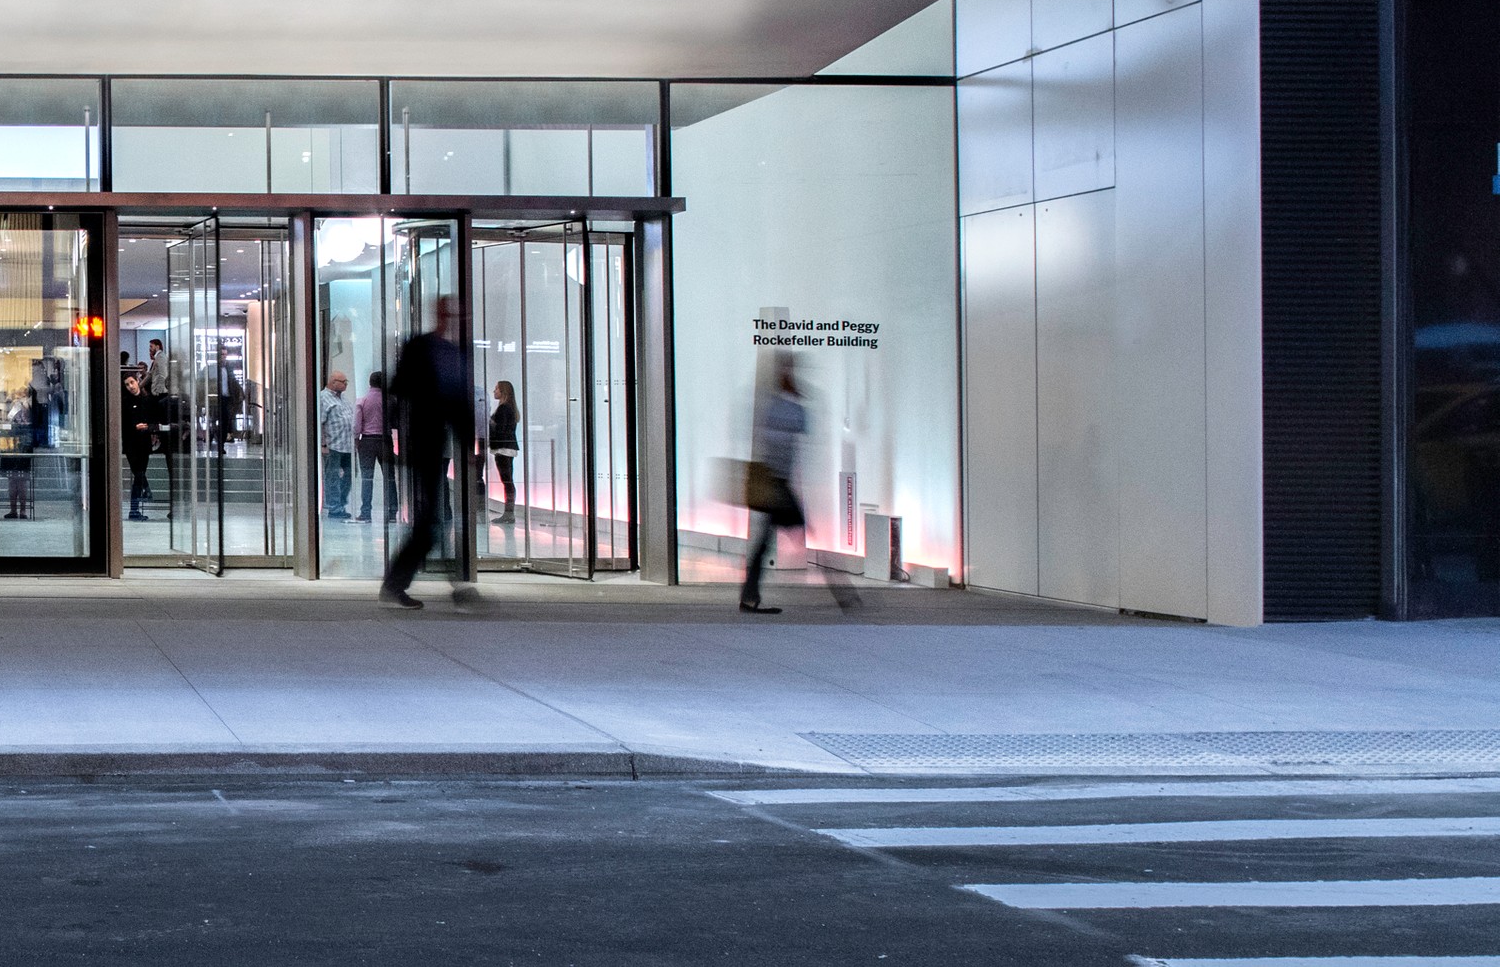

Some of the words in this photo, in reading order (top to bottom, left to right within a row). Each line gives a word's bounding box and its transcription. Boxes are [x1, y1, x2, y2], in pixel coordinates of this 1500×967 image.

[752, 319, 777, 330] The
[778, 319, 814, 331] David
[815, 320, 840, 331] and
[841, 320, 880, 334] Peggy
[752, 334, 825, 346] Rockefeller
[826, 335, 879, 350] Building
